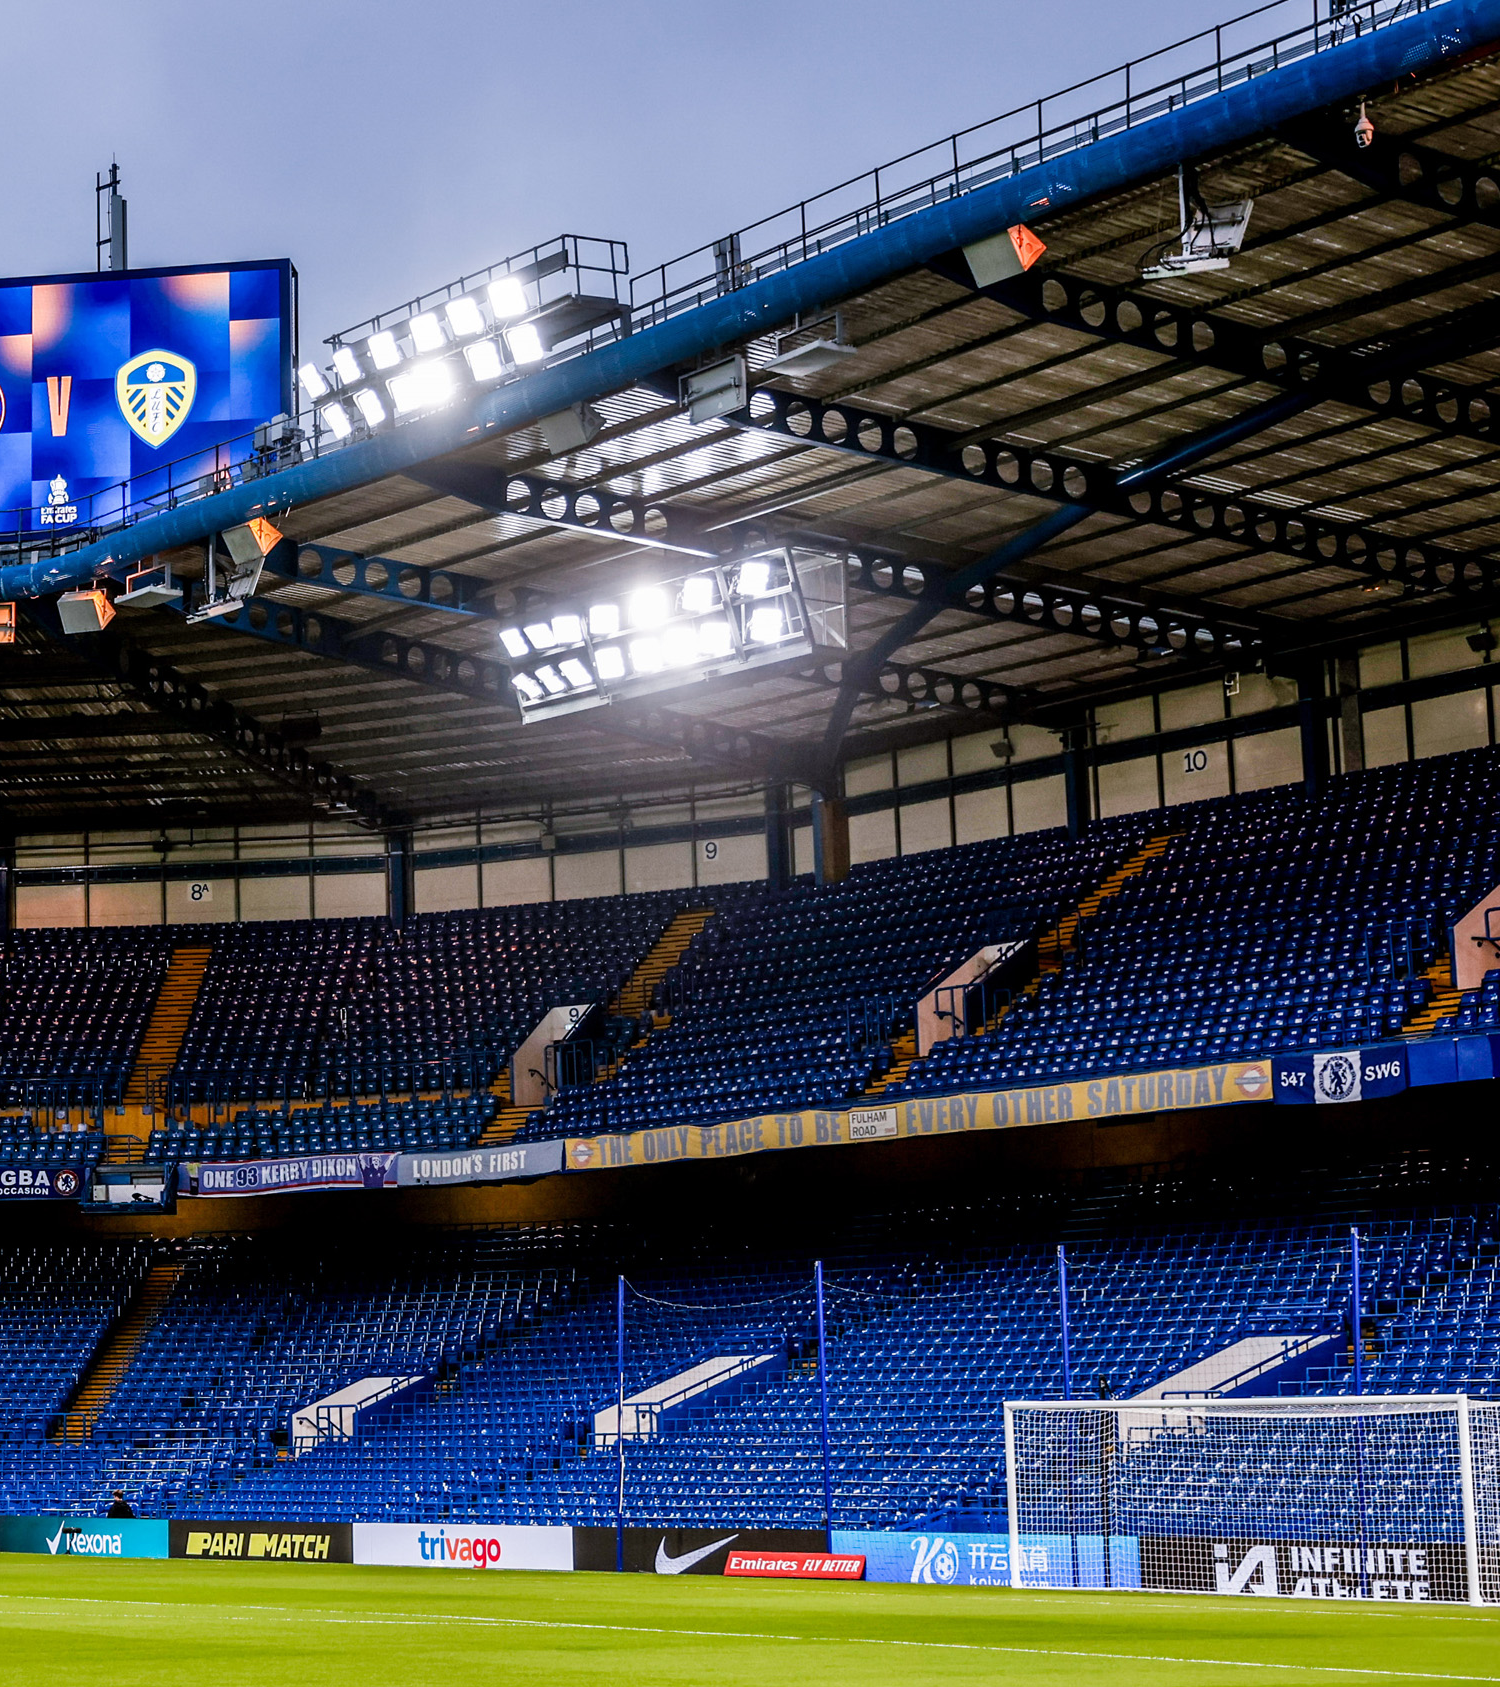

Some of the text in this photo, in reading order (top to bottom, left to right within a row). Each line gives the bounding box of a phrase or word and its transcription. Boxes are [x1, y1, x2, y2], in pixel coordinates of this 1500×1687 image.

[46, 376, 73, 437] V
[41, 513, 78, 524] FA CUP
[1184, 750, 1207, 774] 10
[705, 841, 718, 860] 9
[190, 882, 209, 901] 8A
[569, 1007, 580, 1023] 9
[1280, 1072, 1307, 1088] 547
[1364, 1061, 1401, 1082] SW6
[596, 1066, 1228, 1166] THE ONLY PLACE TO BE EVERY OTHER SATURDAY
[851, 1111, 887, 1124] FULHAM
[852, 1125, 877, 1137] ROAD
[203, 1158, 357, 1188] ONE 93 KERRY DIXON
[413, 1150, 527, 1178] LONDON'S FIRST
[66, 1532, 120, 1555] Rexona
[185, 1531, 331, 1559] PARI MATCH
[417, 1528, 501, 1569] trivago
[730, 1556, 862, 1573] Emirates FLY BETTER
[1291, 1546, 1429, 1576] INFINITE
